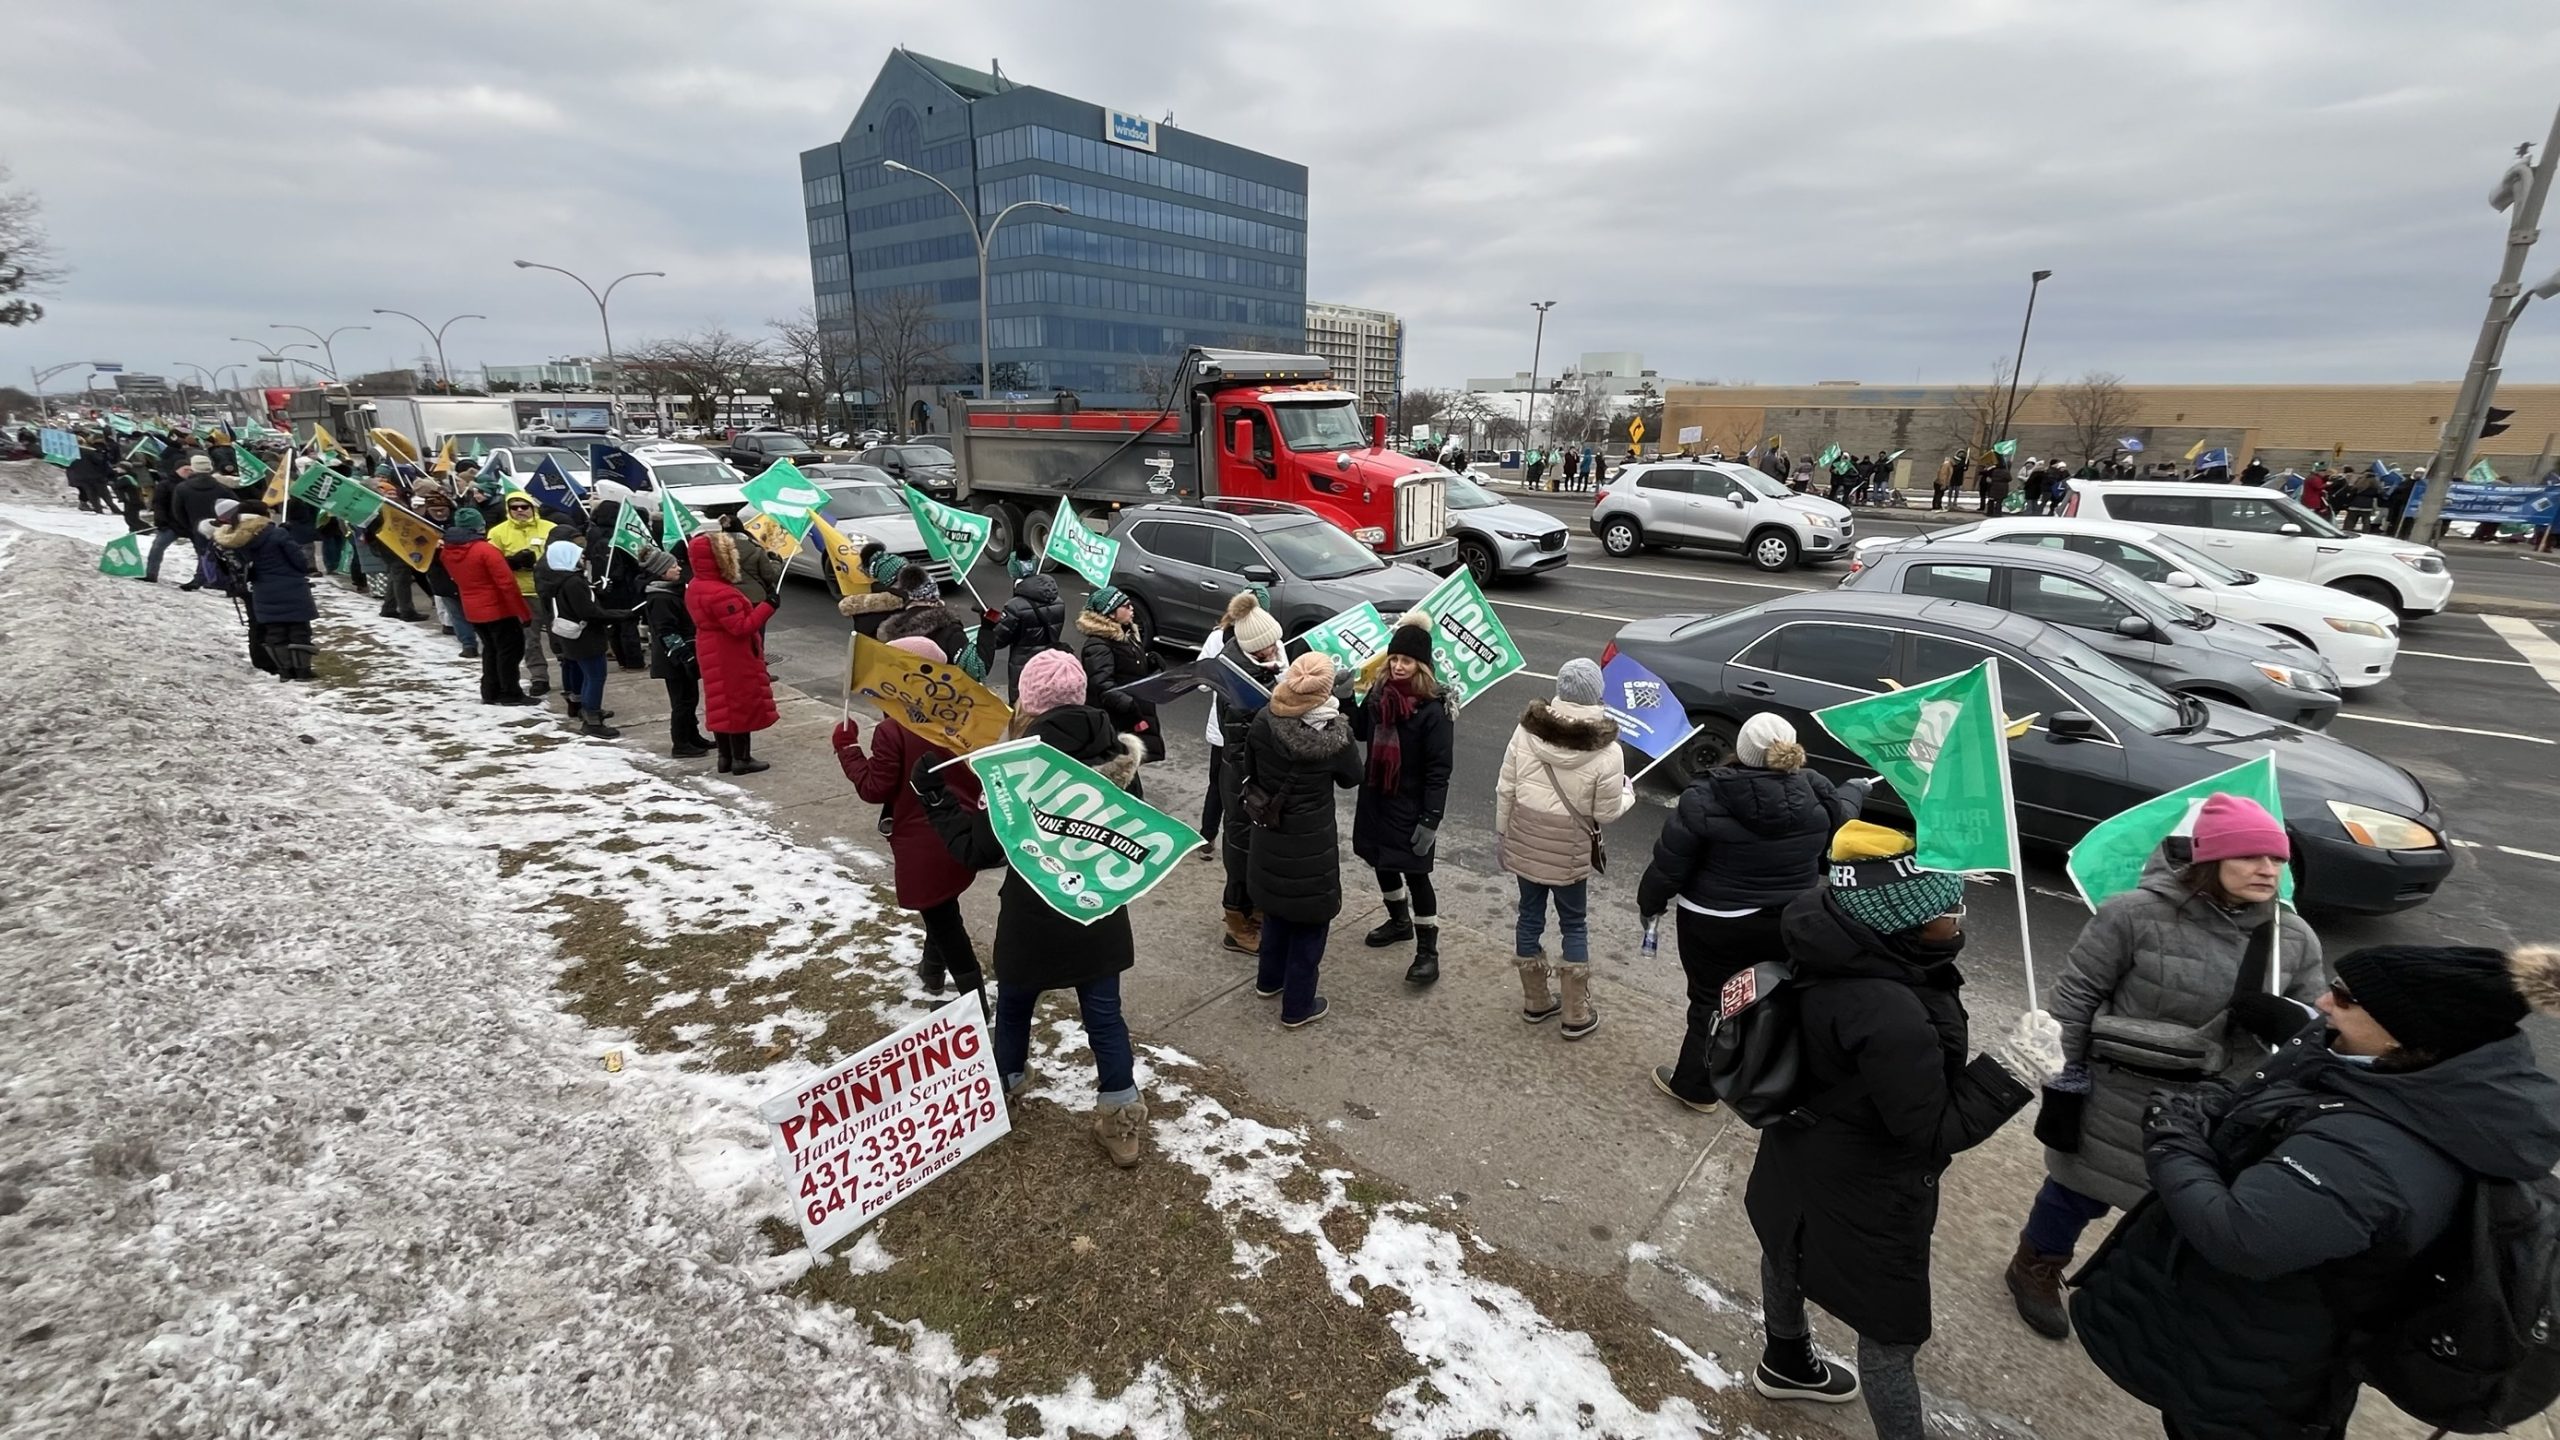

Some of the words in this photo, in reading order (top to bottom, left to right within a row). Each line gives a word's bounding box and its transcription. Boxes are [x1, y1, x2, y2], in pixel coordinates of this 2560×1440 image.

[1115, 123, 1148, 141] windsor
[1429, 579, 1509, 682] NOUS
[1442, 615, 1463, 637] D'UNE
[1460, 630, 1481, 650] SEULE
[1478, 644, 1495, 662] VOIX
[1004, 756, 1175, 891] NOUS
[1066, 821, 1108, 843] SEULE
[1109, 835, 1144, 860] VOIX
[780, 1024, 980, 1154] PAINTING
[797, 1018, 955, 1109] PROFESSIONAL
[794, 1101, 903, 1173] Handyman
[909, 1058, 986, 1107] Services
[800, 1078, 992, 1199] 437-339-2479
[807, 1100, 996, 1226] 647-332-2479
[861, 1189, 893, 1216] Free
